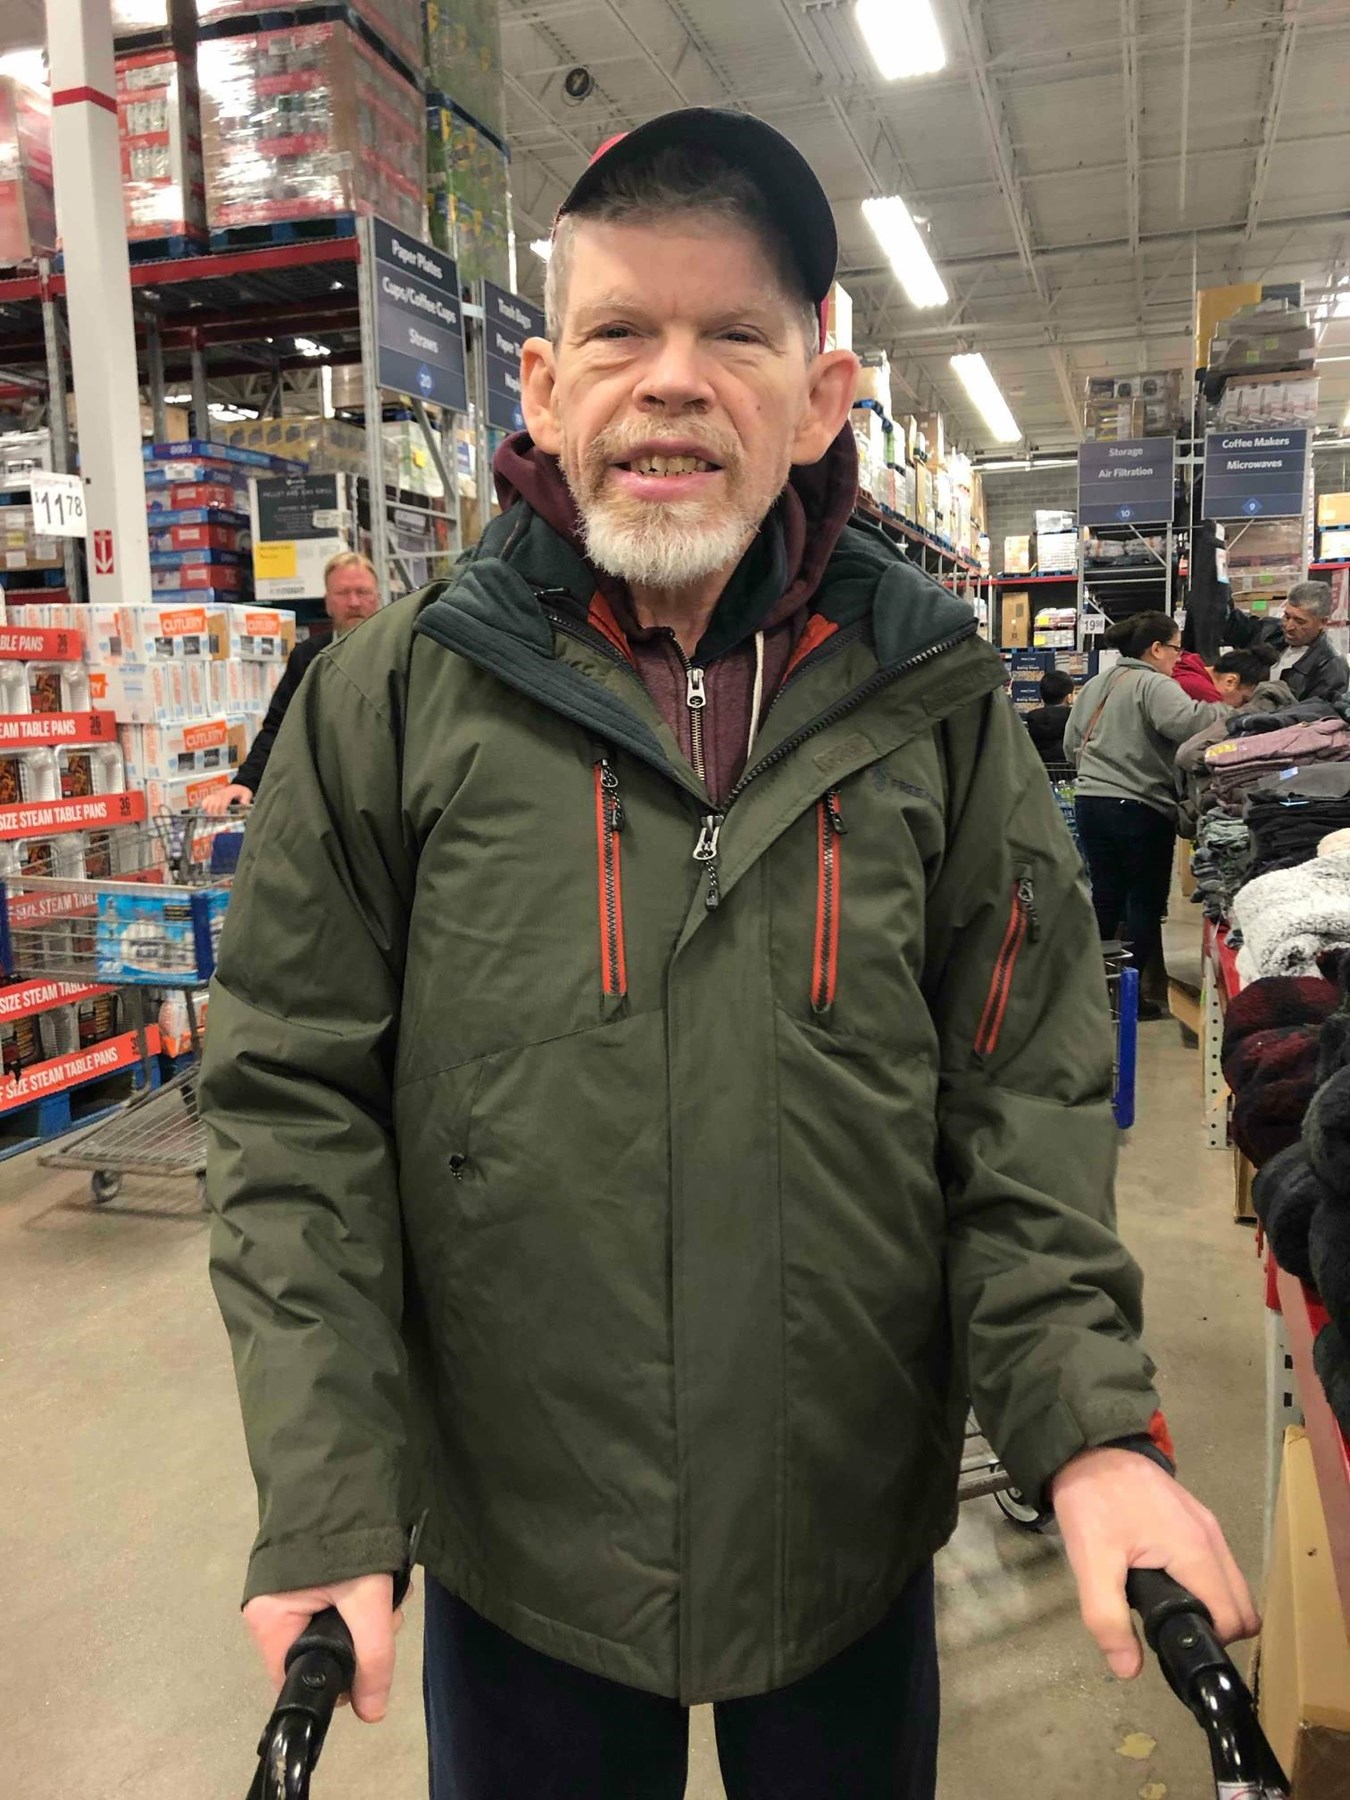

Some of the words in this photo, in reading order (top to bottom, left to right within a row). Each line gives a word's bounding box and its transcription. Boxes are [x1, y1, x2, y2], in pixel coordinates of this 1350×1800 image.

[392, 239, 417, 265] Paper
[416, 252, 443, 279] Plates
[436, 302, 457, 324] Cups
[408, 327, 439, 354] Straws
[1222, 439, 1253, 449] Coffee
[1254, 437, 1290, 447] Makers
[1108, 447, 1143, 457] Storage
[1098, 469, 1112, 478] Air
[1113, 467, 1153, 478] Filtration
[1226, 460, 1283, 470] Microwaves
[1120, 509, 1131, 518] 10
[1249, 502, 1256, 511] 9
[20, 636, 44, 652] PANS
[20, 721, 51, 738] TABLE
[52, 719, 76, 736] PANS
[0, 812, 19, 830] SIZE
[20, 808, 54, 828] STEAM
[54, 804, 83, 823] TABLE
[83, 801, 107, 818] PANS
[0, 992, 21, 1014] SIZE
[23, 984, 58, 1007] STEAM
[30, 1065, 64, 1091] STEAM
[65, 1055, 94, 1080] TABLE
[94, 1046, 119, 1067] PANS
